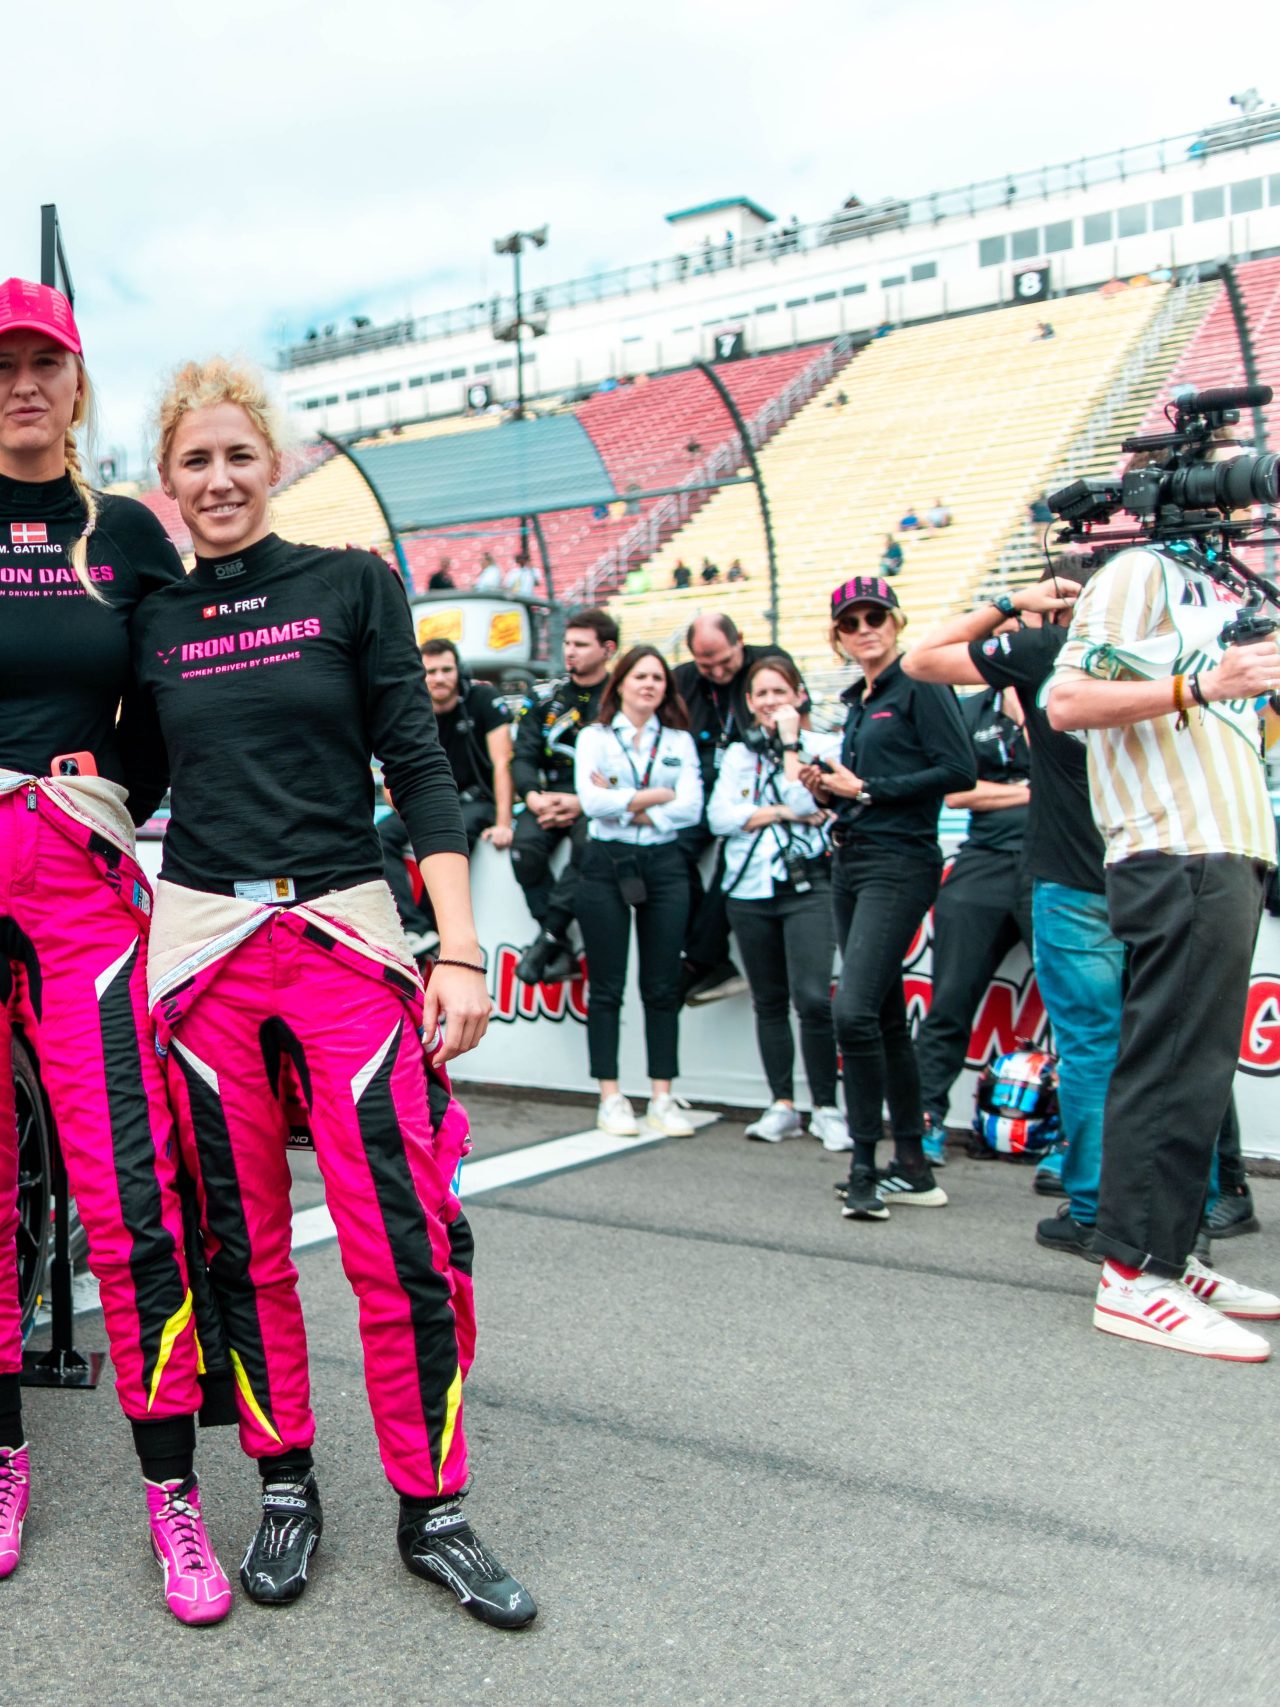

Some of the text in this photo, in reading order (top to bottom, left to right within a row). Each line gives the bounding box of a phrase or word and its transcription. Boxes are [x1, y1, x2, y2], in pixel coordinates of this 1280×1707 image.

[1019, 272, 1042, 297] 8
[718, 334, 737, 358] 7
[13, 544, 62, 554] GATTING
[215, 561, 245, 577] OMP
[219, 597, 268, 615] R. FREY
[182, 618, 321, 662] IRON DAMES
[181, 651, 301, 679] WOMEN DRIVEN BY DREAMS
